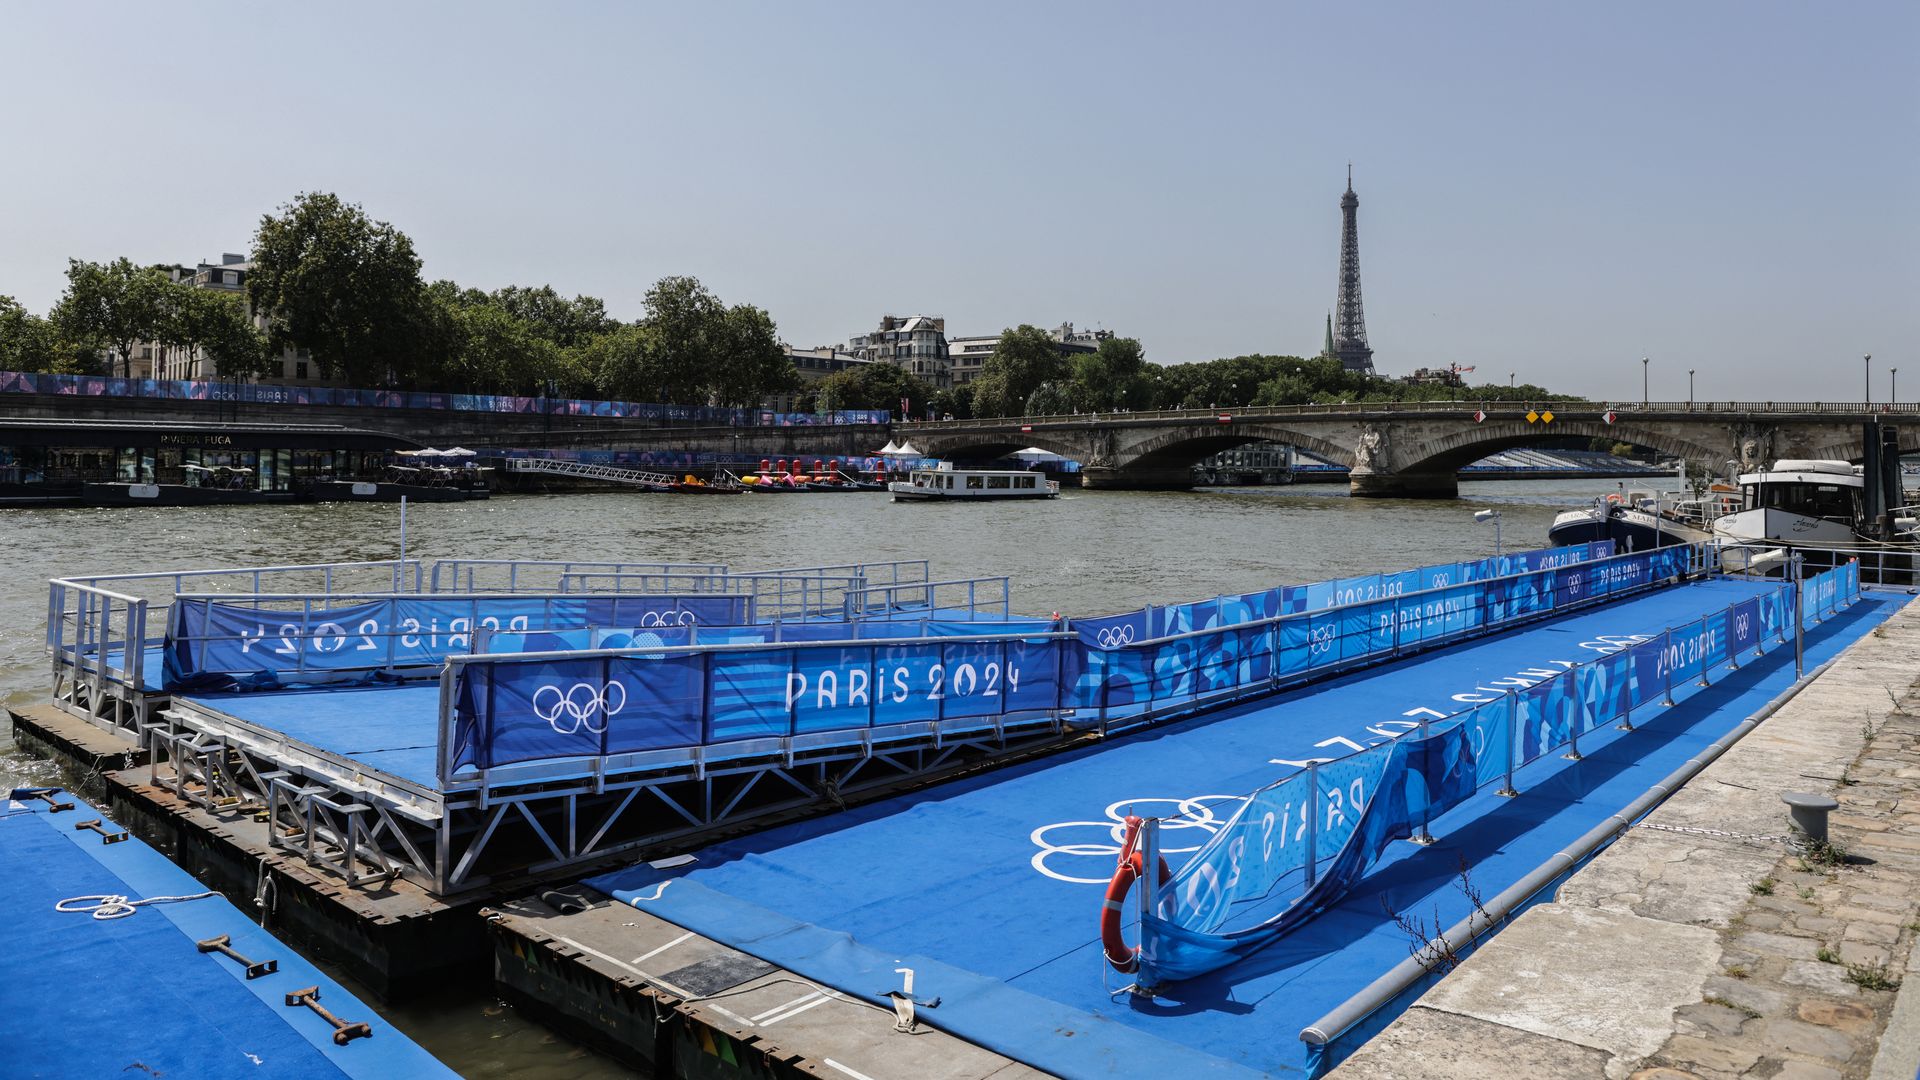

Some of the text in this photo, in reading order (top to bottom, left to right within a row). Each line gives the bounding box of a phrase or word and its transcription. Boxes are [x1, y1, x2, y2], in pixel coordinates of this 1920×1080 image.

[204, 435, 232, 445] FUGA
[1380, 599, 1460, 637] PARIS 2024
[785, 661, 1020, 713] PARIS 2024
